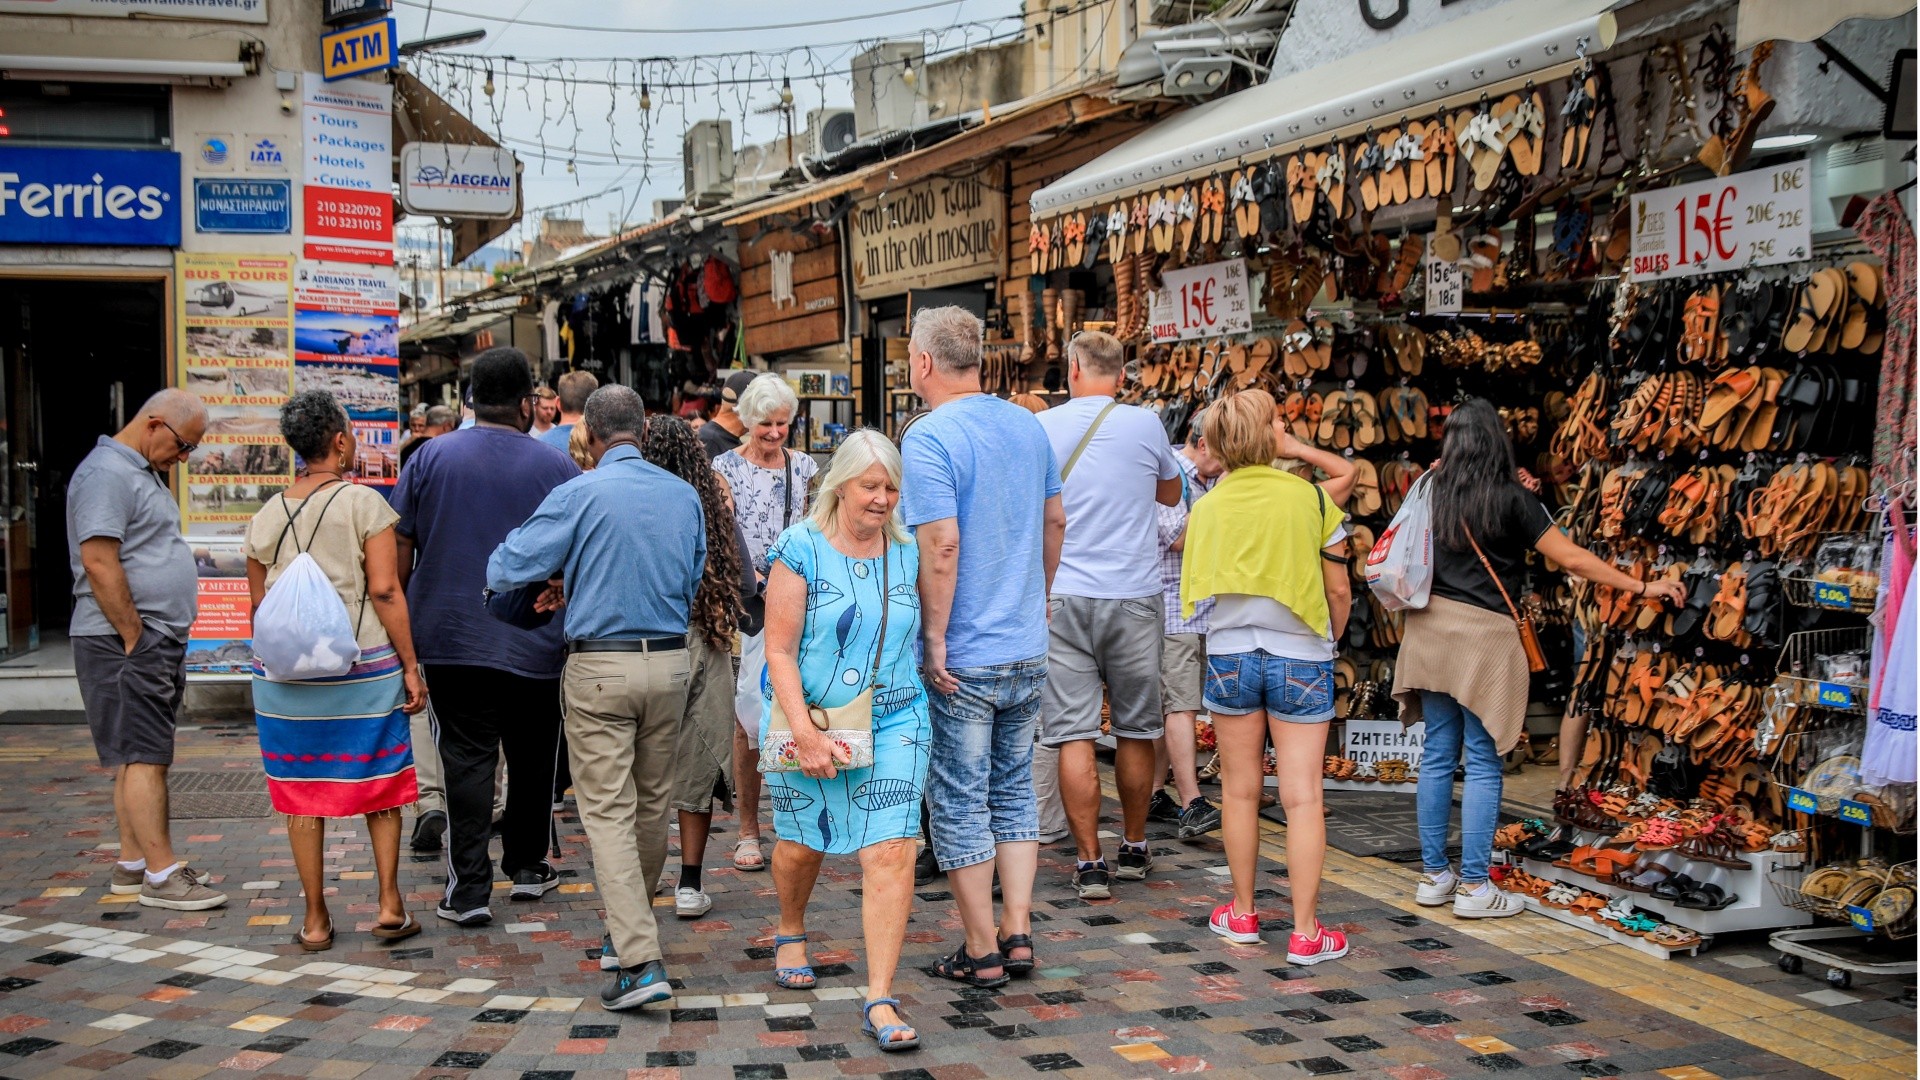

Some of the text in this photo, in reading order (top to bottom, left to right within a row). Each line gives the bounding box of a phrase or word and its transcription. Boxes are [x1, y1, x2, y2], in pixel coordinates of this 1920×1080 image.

[331, 32, 382, 68] ATM
[319, 113, 358, 129] Tours
[319, 133, 385, 152] Packages
[250, 151, 282, 162] IATA
[319, 153, 365, 170] Hotels
[320, 174, 372, 189] Cruises
[450, 174, 510, 187] AEGEAN
[1772, 167, 1804, 193] 18€
[212, 184, 274, 196] ΠΛΑΤΕΙΑ
[201, 198, 285, 212] ΜΟΝΑΣΤΗΡΑΚΙΟΥ
[317, 201, 382, 217] 210 3220702
[1745, 200, 1803, 229] 20€ 22€
[317, 215, 382, 231] 210 3231015
[1674, 186, 1738, 267] 15€
[866, 218, 996, 277] in the old mosque
[1749, 238, 1776, 261] 25€
[1225, 264, 1241, 279] 18€
[1634, 253, 1669, 275] SALES
[184, 270, 288, 280] BUS TOURS
[1428, 262, 1449, 284] 15€
[312, 275, 387, 288] ADRIANOS TRAVEL
[1223, 283, 1239, 298] 20€
[1439, 290, 1455, 306] 18€
[1180, 277, 1217, 329] 15€
[1231, 299, 1245, 312] 22€
[1153, 323, 1177, 338] SALES
[200, 358, 228, 366] DAY
[235, 359, 290, 367] DELPHI
[200, 435, 223, 444] APE
[188, 476, 290, 484] 2 DAYS METEORA
[209, 582, 249, 591] METEO
